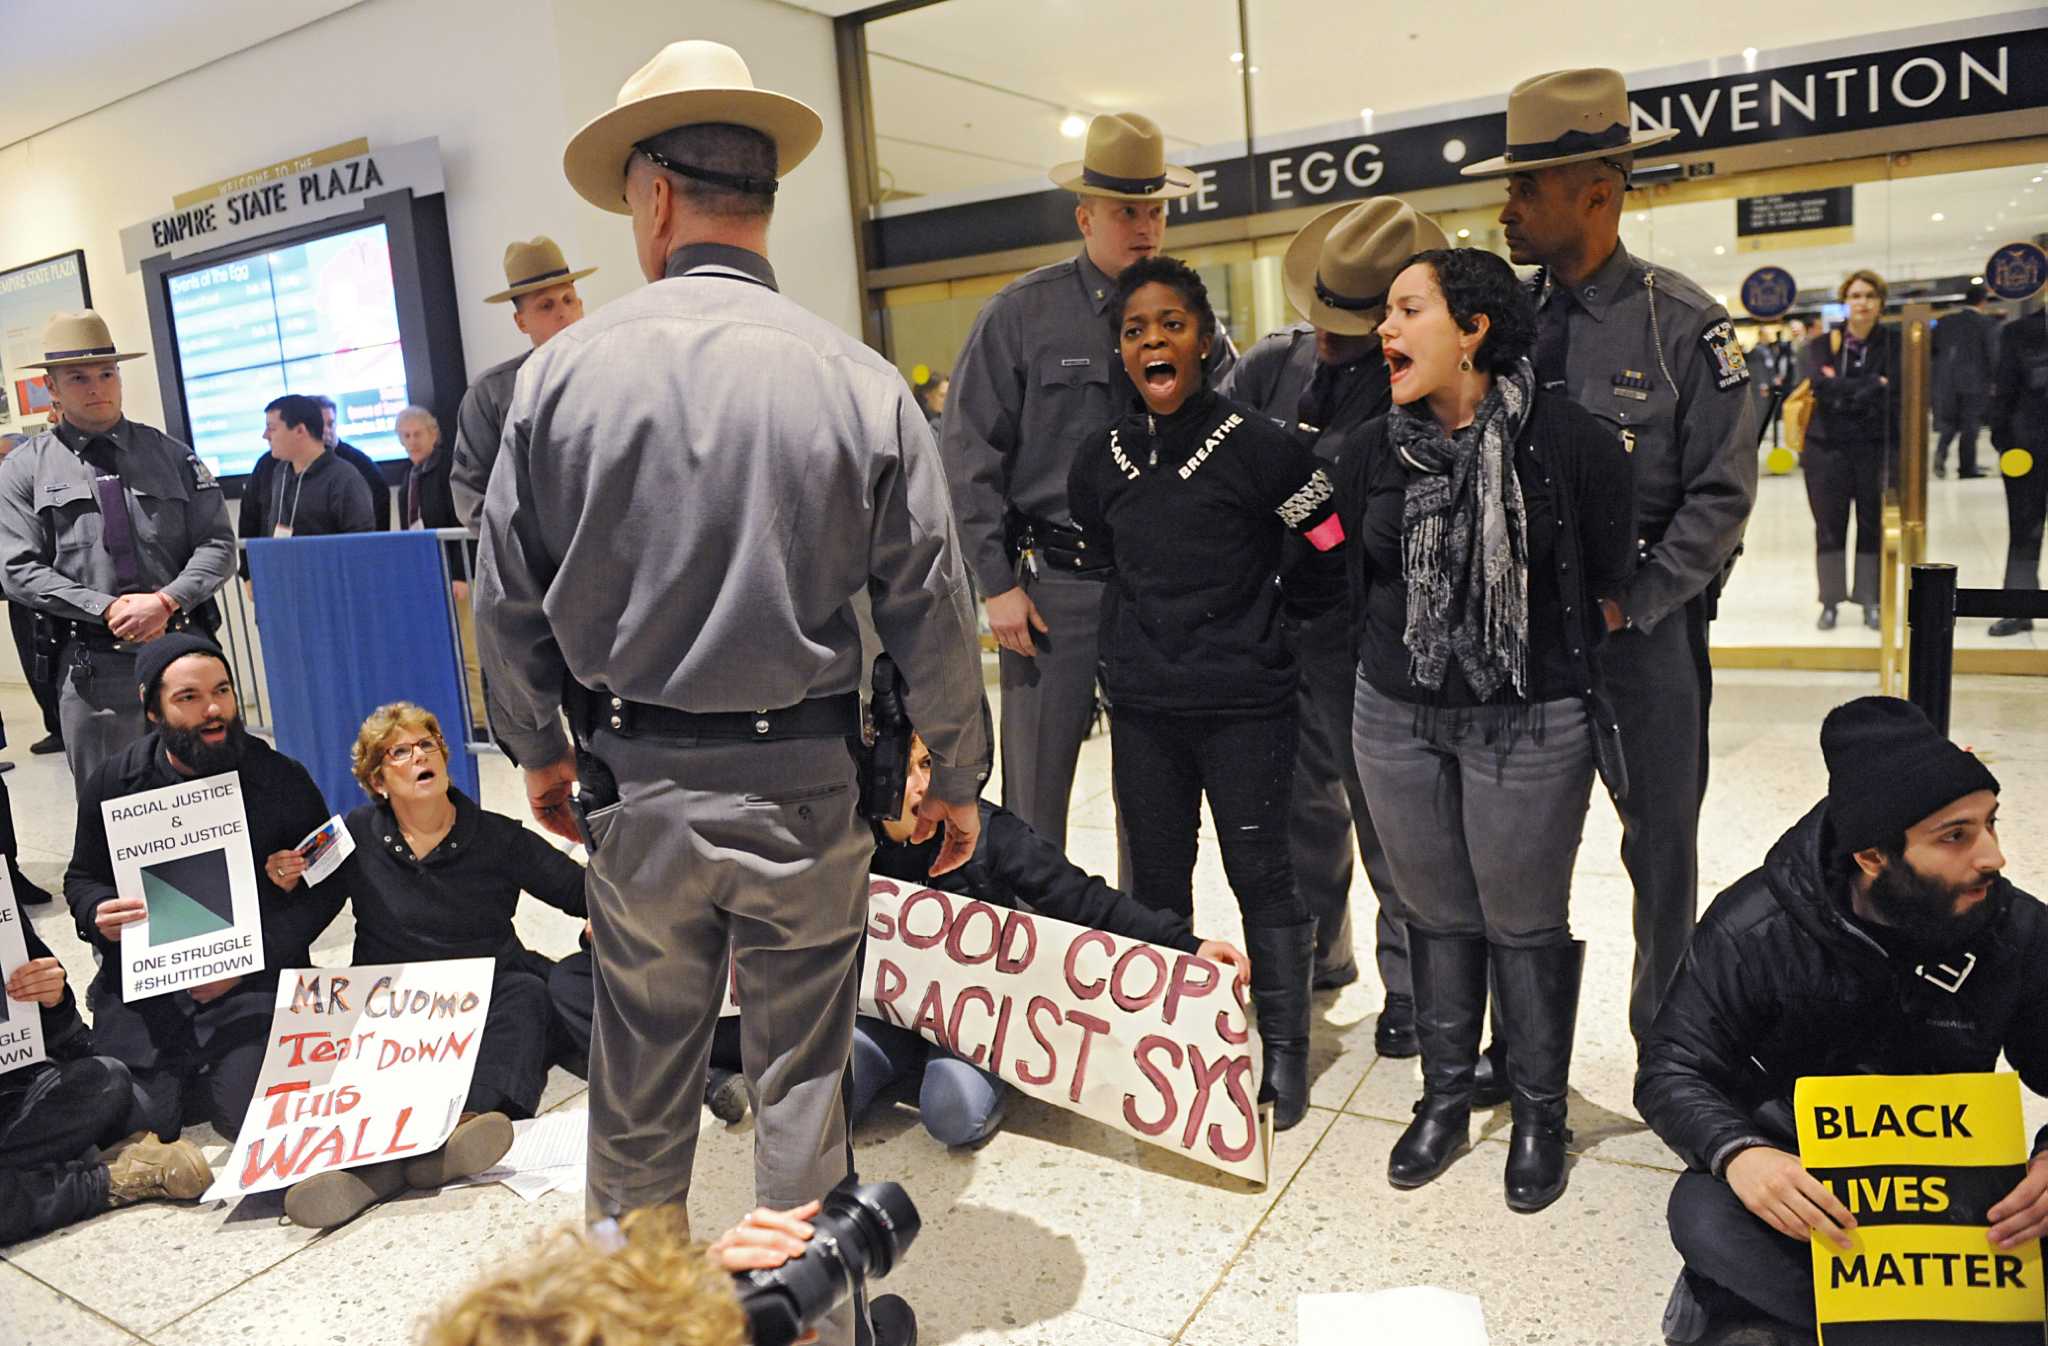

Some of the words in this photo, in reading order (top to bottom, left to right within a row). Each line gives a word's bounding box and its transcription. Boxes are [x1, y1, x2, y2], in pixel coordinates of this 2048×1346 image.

[220, 170, 269, 193] WELCOME
[275, 165, 288, 178] TO
[294, 157, 313, 172] THE
[1269, 143, 1384, 200] EGG
[152, 204, 217, 248] EMPIRE
[228, 183, 287, 226] STATE
[300, 158, 384, 206] PLAZA
[228, 264, 249, 283] Egg
[1178, 413, 1244, 480] BREATHE
[111, 798, 168, 822] RACIAL
[170, 783, 234, 809] JUSTICE
[171, 815, 183, 828] &
[117, 836, 176, 861] ENVIRO
[180, 820, 243, 846] JUSTICE
[132, 955, 166, 974] ONE
[171, 934, 253, 965] STRUGGLE
[133, 953, 254, 992] #SHUTITDOWN
[868, 879, 1037, 974] GOOD
[1064, 929, 1251, 1045] COPS
[289, 974, 351, 1016] MR
[874, 958, 1111, 1104] RACIST
[1123, 1034, 1256, 1162] SYS
[264, 1080, 362, 1130] THIS
[1813, 1103, 1973, 1140] BLACK
[238, 1106, 418, 1189] WALL
[1830, 1252, 2027, 1290] MATTER
